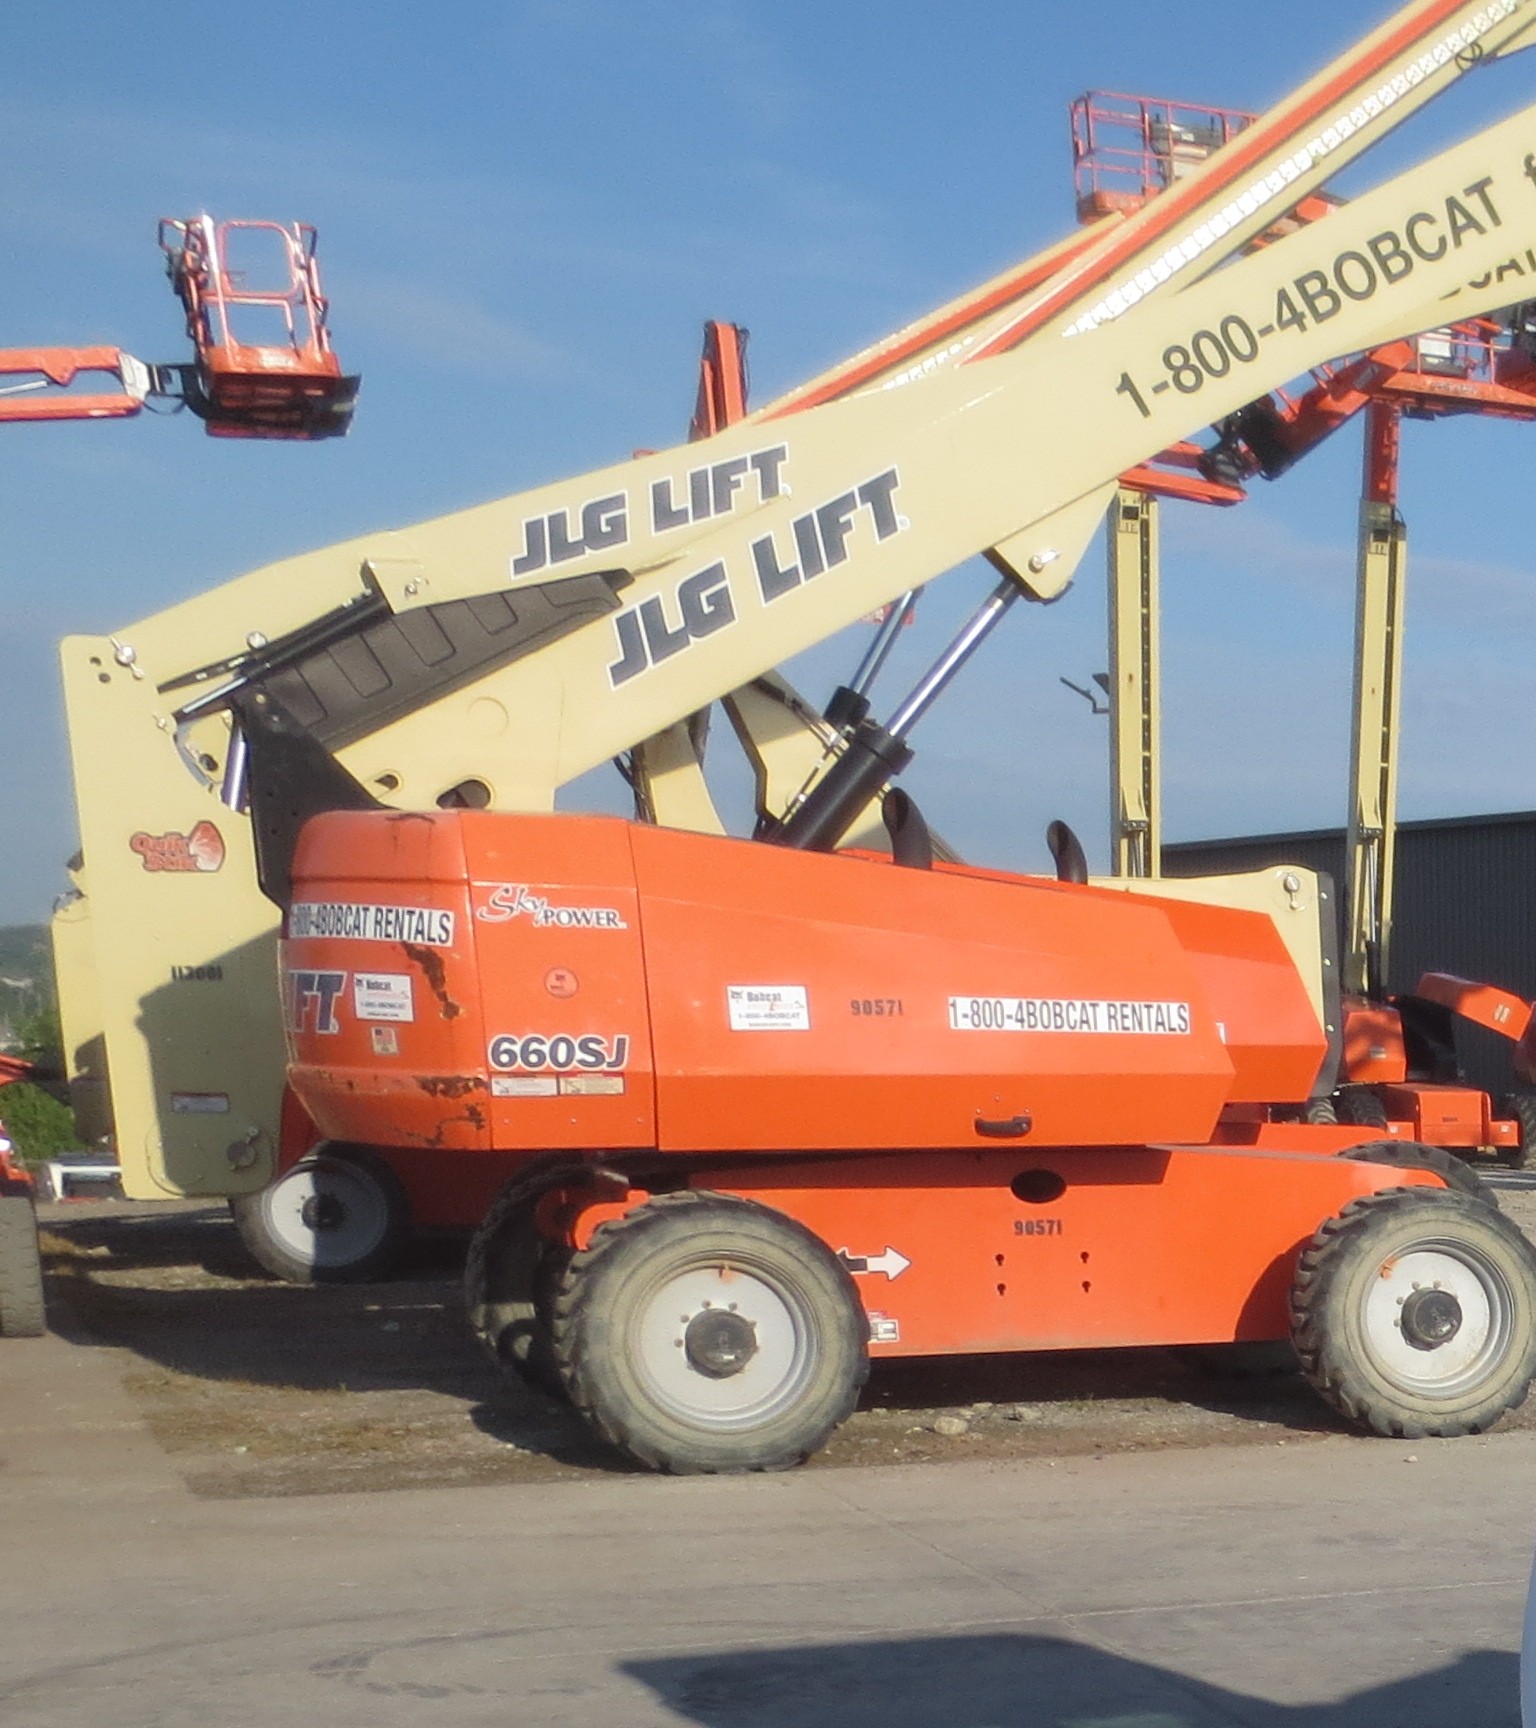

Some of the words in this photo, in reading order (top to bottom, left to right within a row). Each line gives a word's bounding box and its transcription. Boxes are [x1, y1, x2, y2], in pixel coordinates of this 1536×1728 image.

[1115, 177, 1502, 419] 1-800-4BOBCAT
[511, 490, 629, 578] JLG
[650, 442, 789, 534] LIFT
[607, 557, 737, 691] JLG
[749, 464, 899, 606] LIFT
[374, 906, 451, 944] RENTALS
[850, 999, 904, 1016] 90571
[949, 999, 1100, 1030] 1-800-4BOBCAT
[1107, 1003, 1189, 1033] RENTALS
[489, 1034, 628, 1070] 660SJ
[1014, 1219, 1063, 1236] 90571
